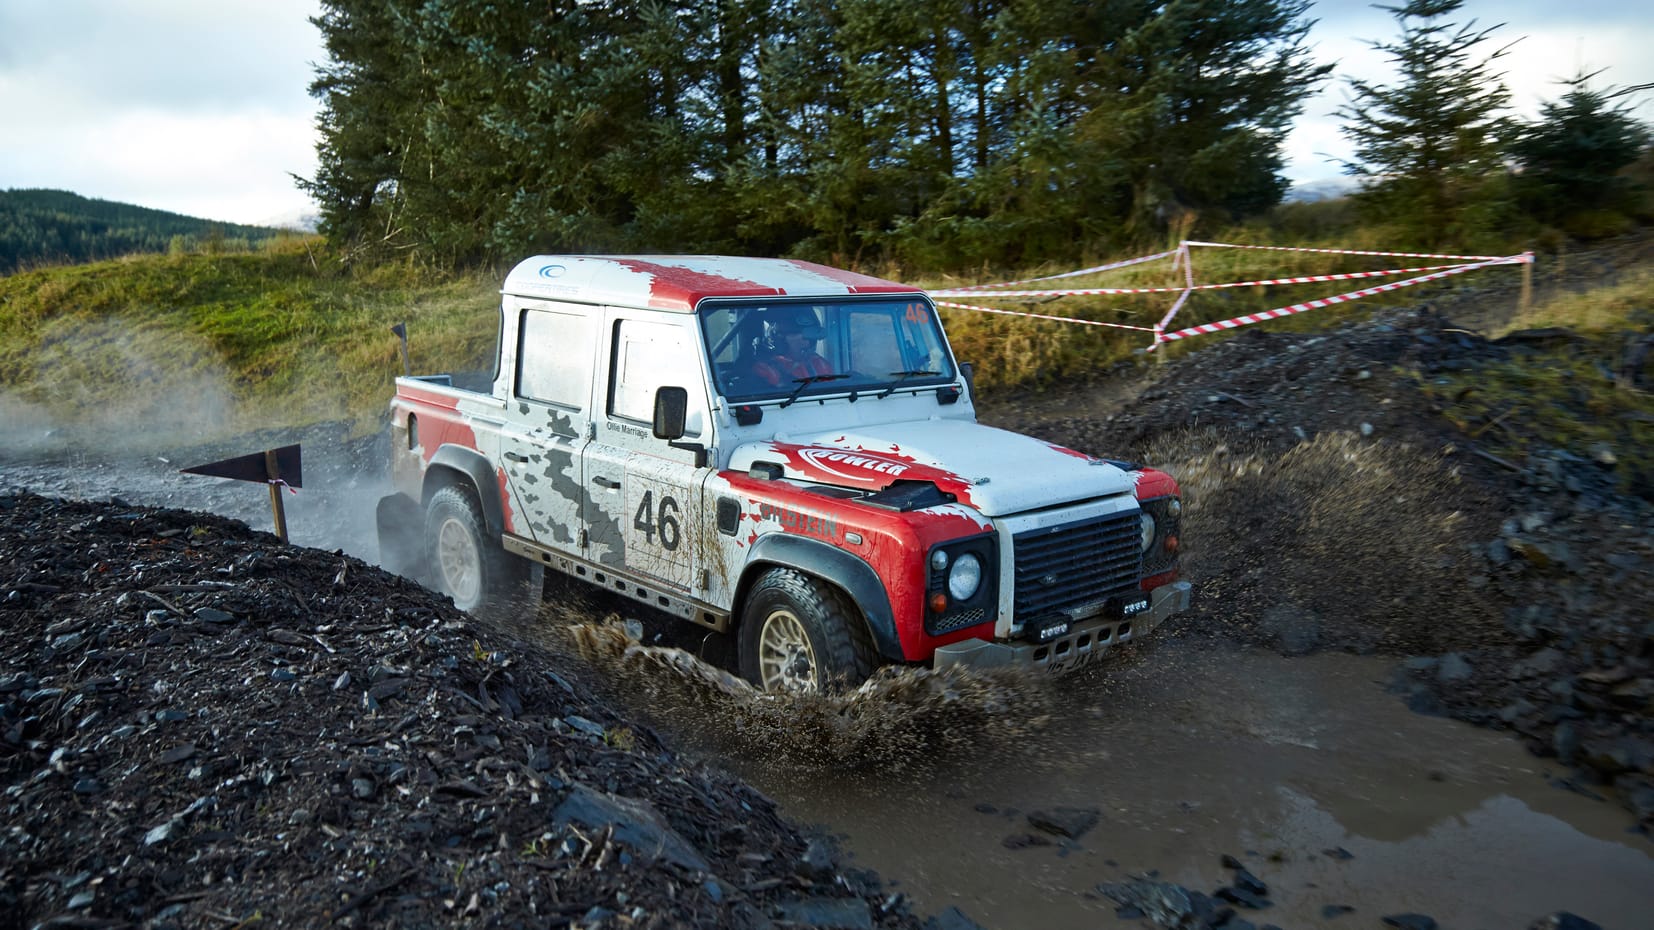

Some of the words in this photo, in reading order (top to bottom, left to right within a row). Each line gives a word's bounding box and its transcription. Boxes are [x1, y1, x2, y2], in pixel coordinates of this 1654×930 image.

[905, 303, 929, 324] 46
[606, 421, 620, 433] Ollie
[621, 424, 649, 440] Marriage
[812, 449, 908, 477] BOWLER
[633, 490, 681, 552] 46
[760, 496, 838, 538] BILSTEIN
